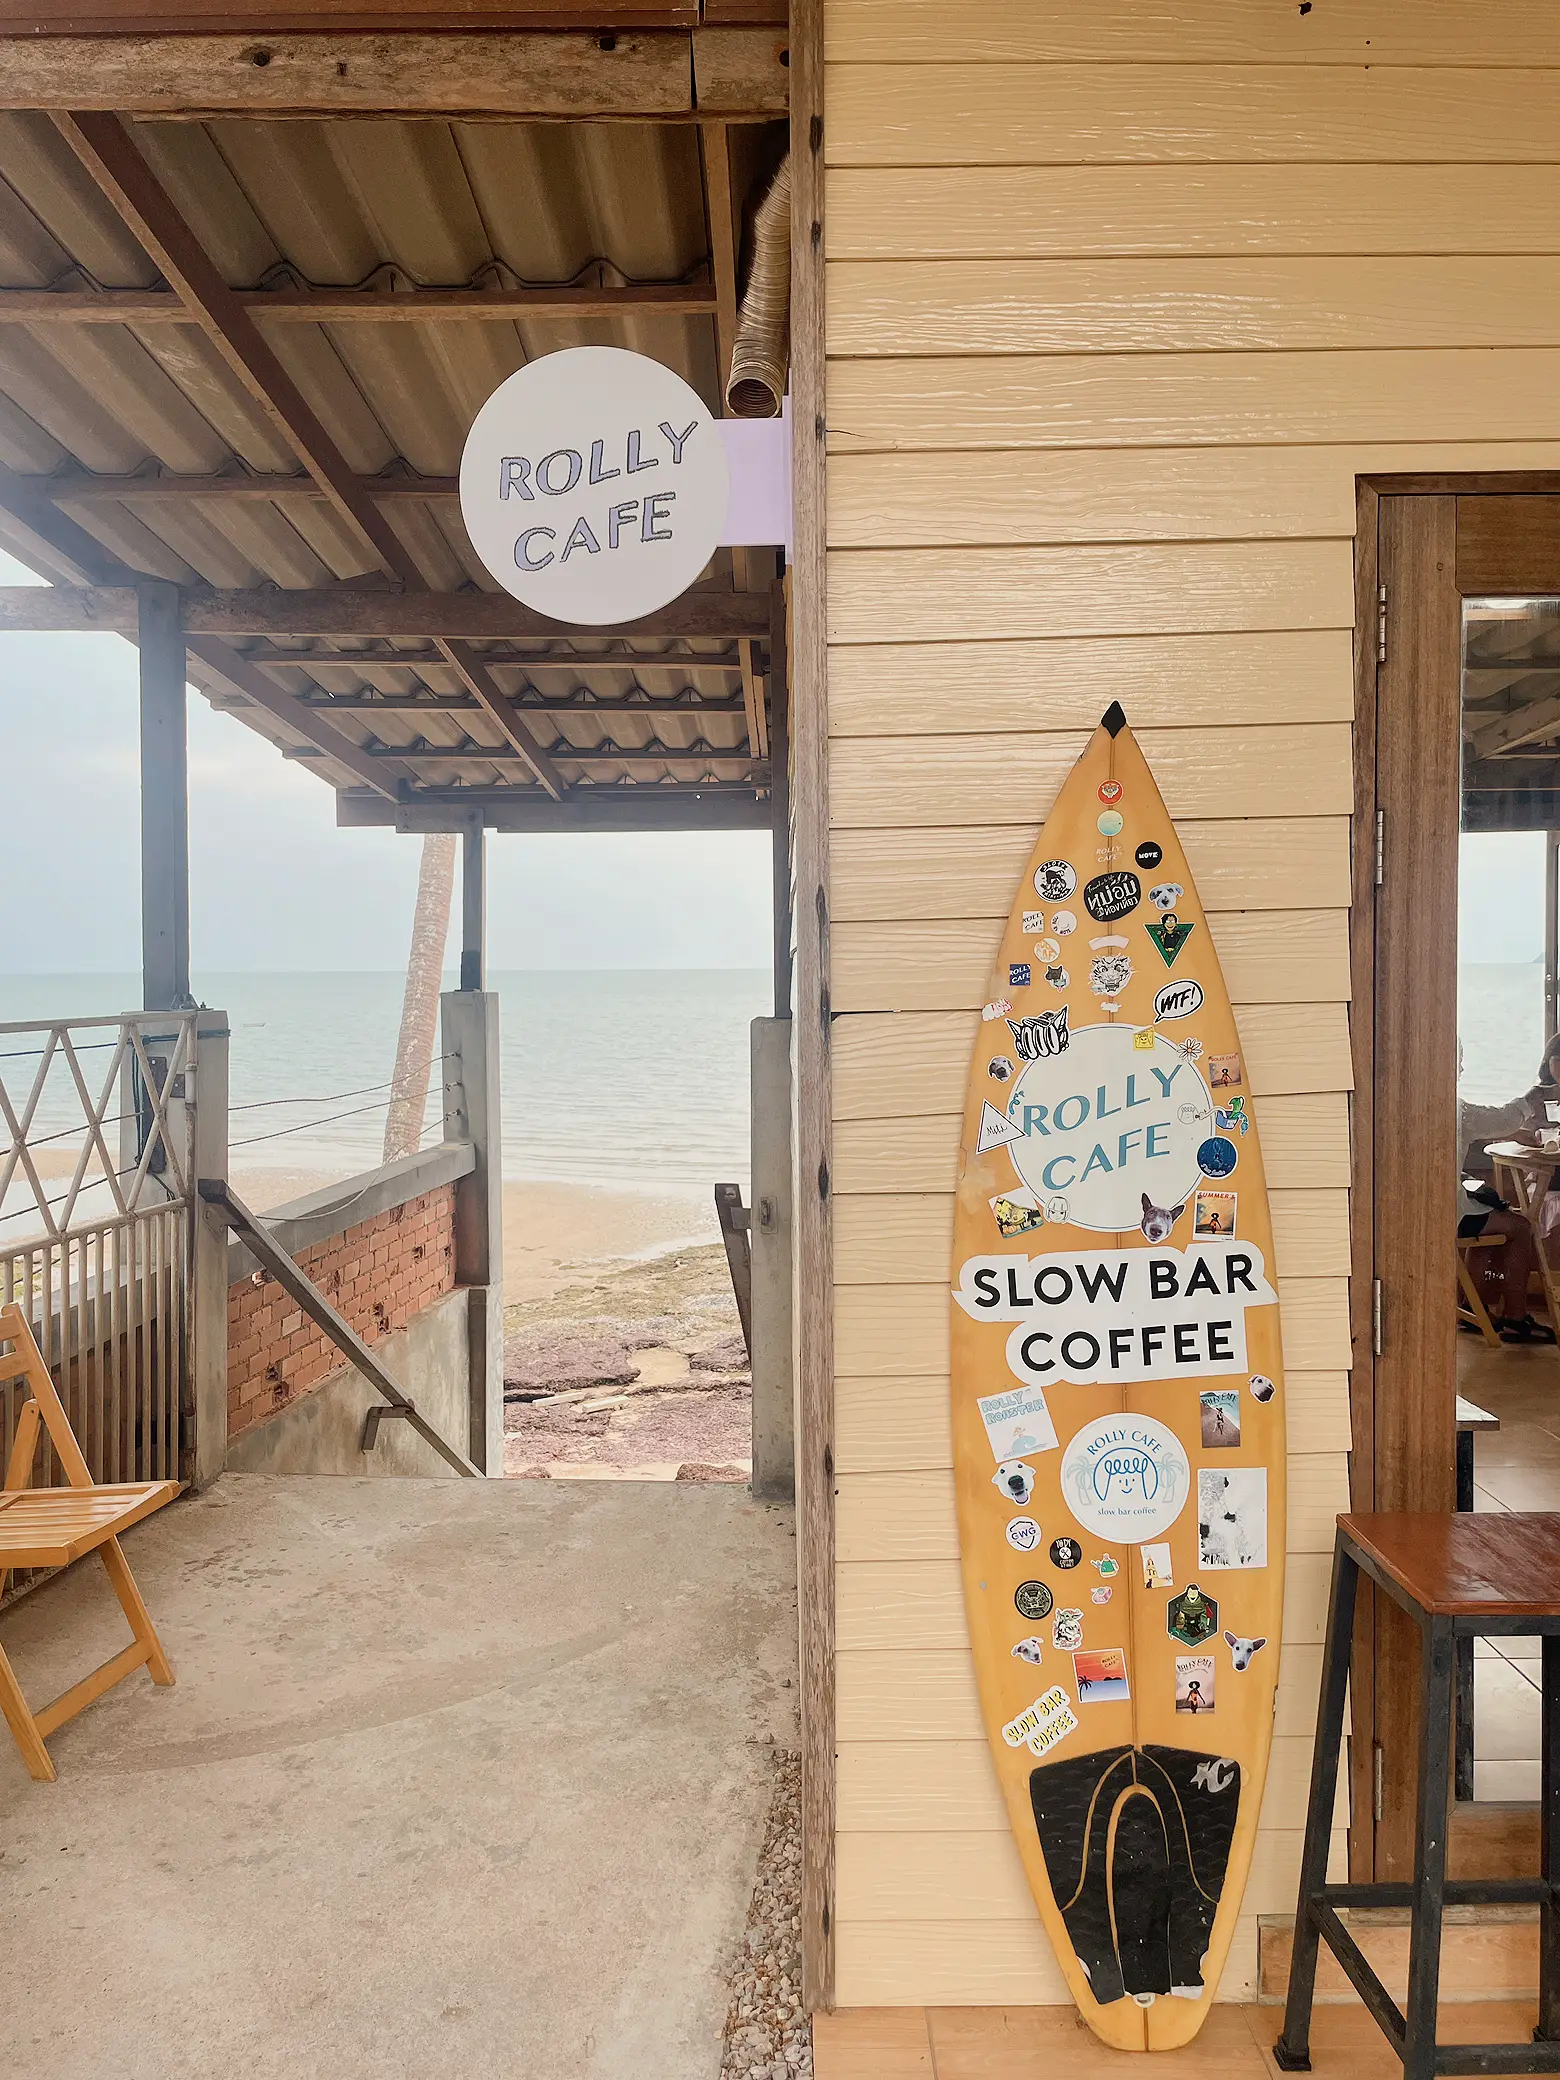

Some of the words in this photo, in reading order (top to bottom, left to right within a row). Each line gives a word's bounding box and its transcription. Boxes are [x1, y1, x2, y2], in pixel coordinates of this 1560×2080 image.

[499, 420, 699, 501] ROLLY
[513, 491, 677, 572] CAFE
[1095, 846, 1122, 856] ROLLY
[1097, 854, 1118, 863] CAFE
[1011, 972, 1031, 984] CAFE
[1160, 986, 1196, 1014] WTF!
[1023, 1064, 1183, 1138] ROLLY
[1041, 1121, 1172, 1191] CAFE
[973, 1262, 1129, 1308] SLOW
[1149, 1253, 1258, 1300] BAR
[1020, 1320, 1235, 1372] COFFEE
[981, 1390, 1024, 1413] ROLLY
[985, 1398, 1045, 1426] ROASTER
[1086, 1429, 1127, 1456] ROLLY
[1131, 1430, 1163, 1454] CAFE
[1097, 1507, 1117, 1516] slow
[1118, 1507, 1131, 1516] bar
[1133, 1506, 1157, 1516] coffee
[1011, 1526, 1036, 1541] GWG
[1006, 1710, 1040, 1742] SLOW
[1038, 1690, 1066, 1717] BAR
[1031, 1710, 1074, 1752] COFFEE
